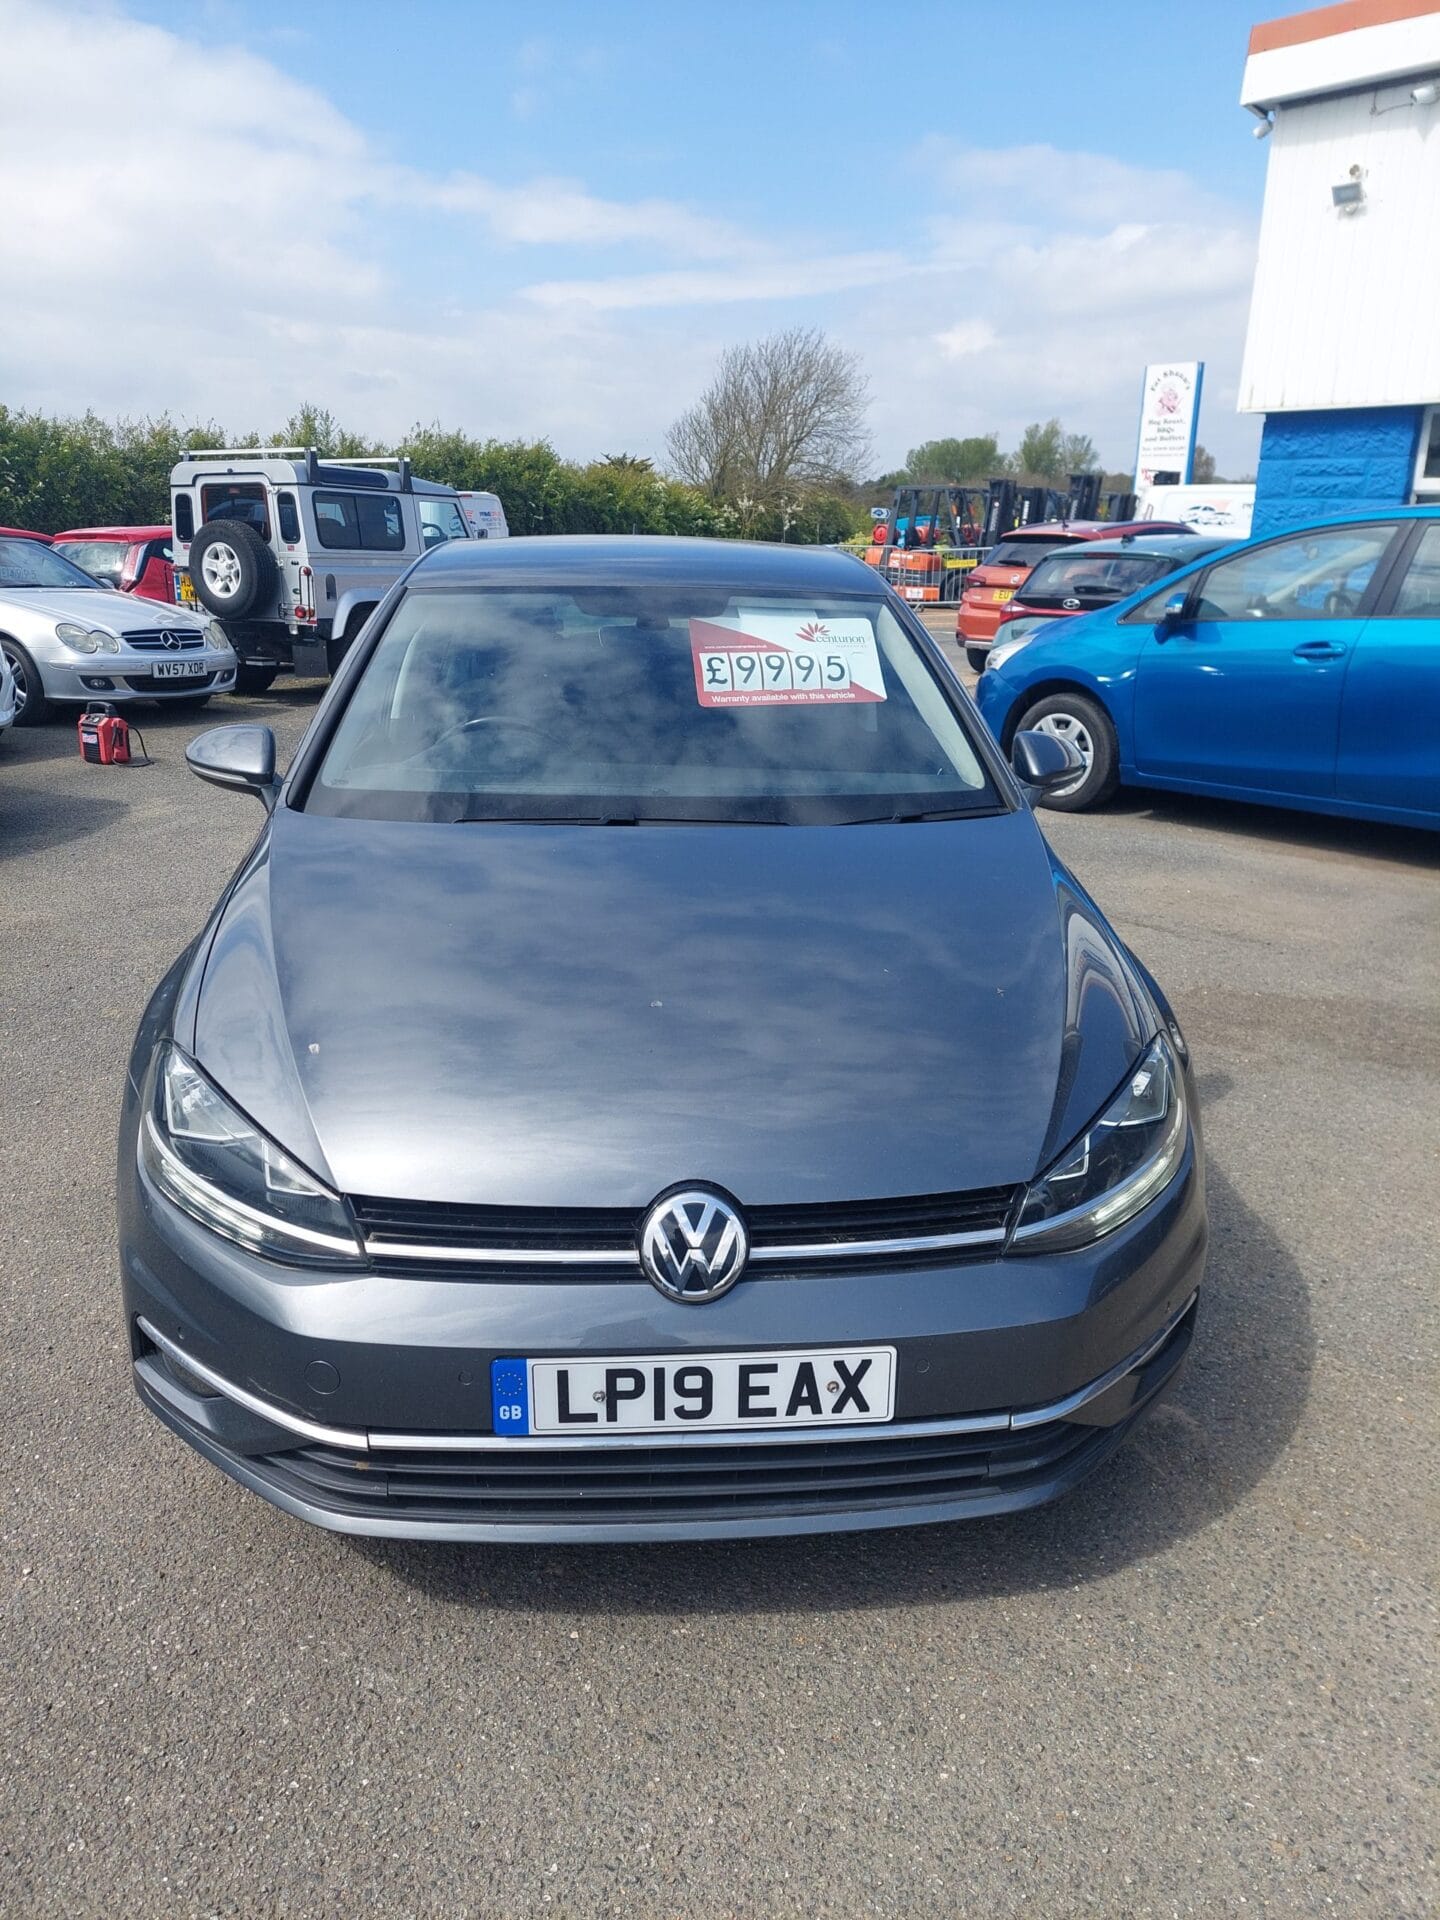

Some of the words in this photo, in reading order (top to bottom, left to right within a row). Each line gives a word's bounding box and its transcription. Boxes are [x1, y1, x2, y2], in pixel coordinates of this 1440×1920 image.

[157, 663, 185, 676] WV57
[706, 655, 846, 685] £9995
[711, 694, 750, 704] Warranty
[752, 693, 789, 702] available
[790, 692, 808, 701] with
[809, 692, 825, 700] this
[556, 1366, 714, 1424] LP19
[737, 1358, 873, 1418] EAX
[499, 1404, 522, 1420] GB
